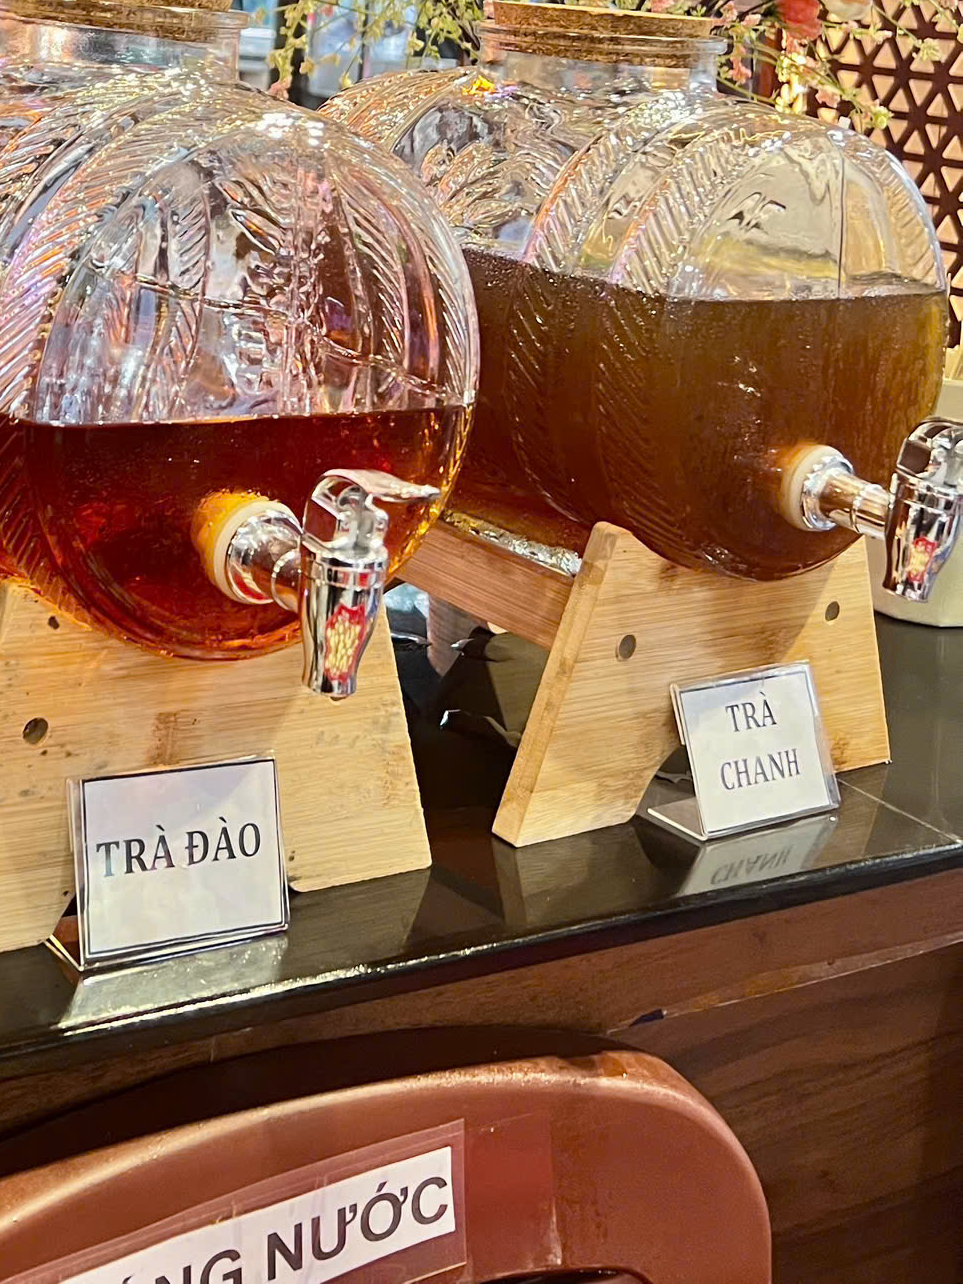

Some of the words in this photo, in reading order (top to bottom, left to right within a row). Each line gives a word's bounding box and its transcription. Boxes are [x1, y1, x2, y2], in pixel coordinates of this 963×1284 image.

[725, 692, 778, 732] TRÀ
[720, 748, 801, 791] CHANH
[96, 824, 175, 878] TRÀ
[185, 816, 261, 866] ĐÀO
[267, 1176, 448, 1282] NƯỚC
